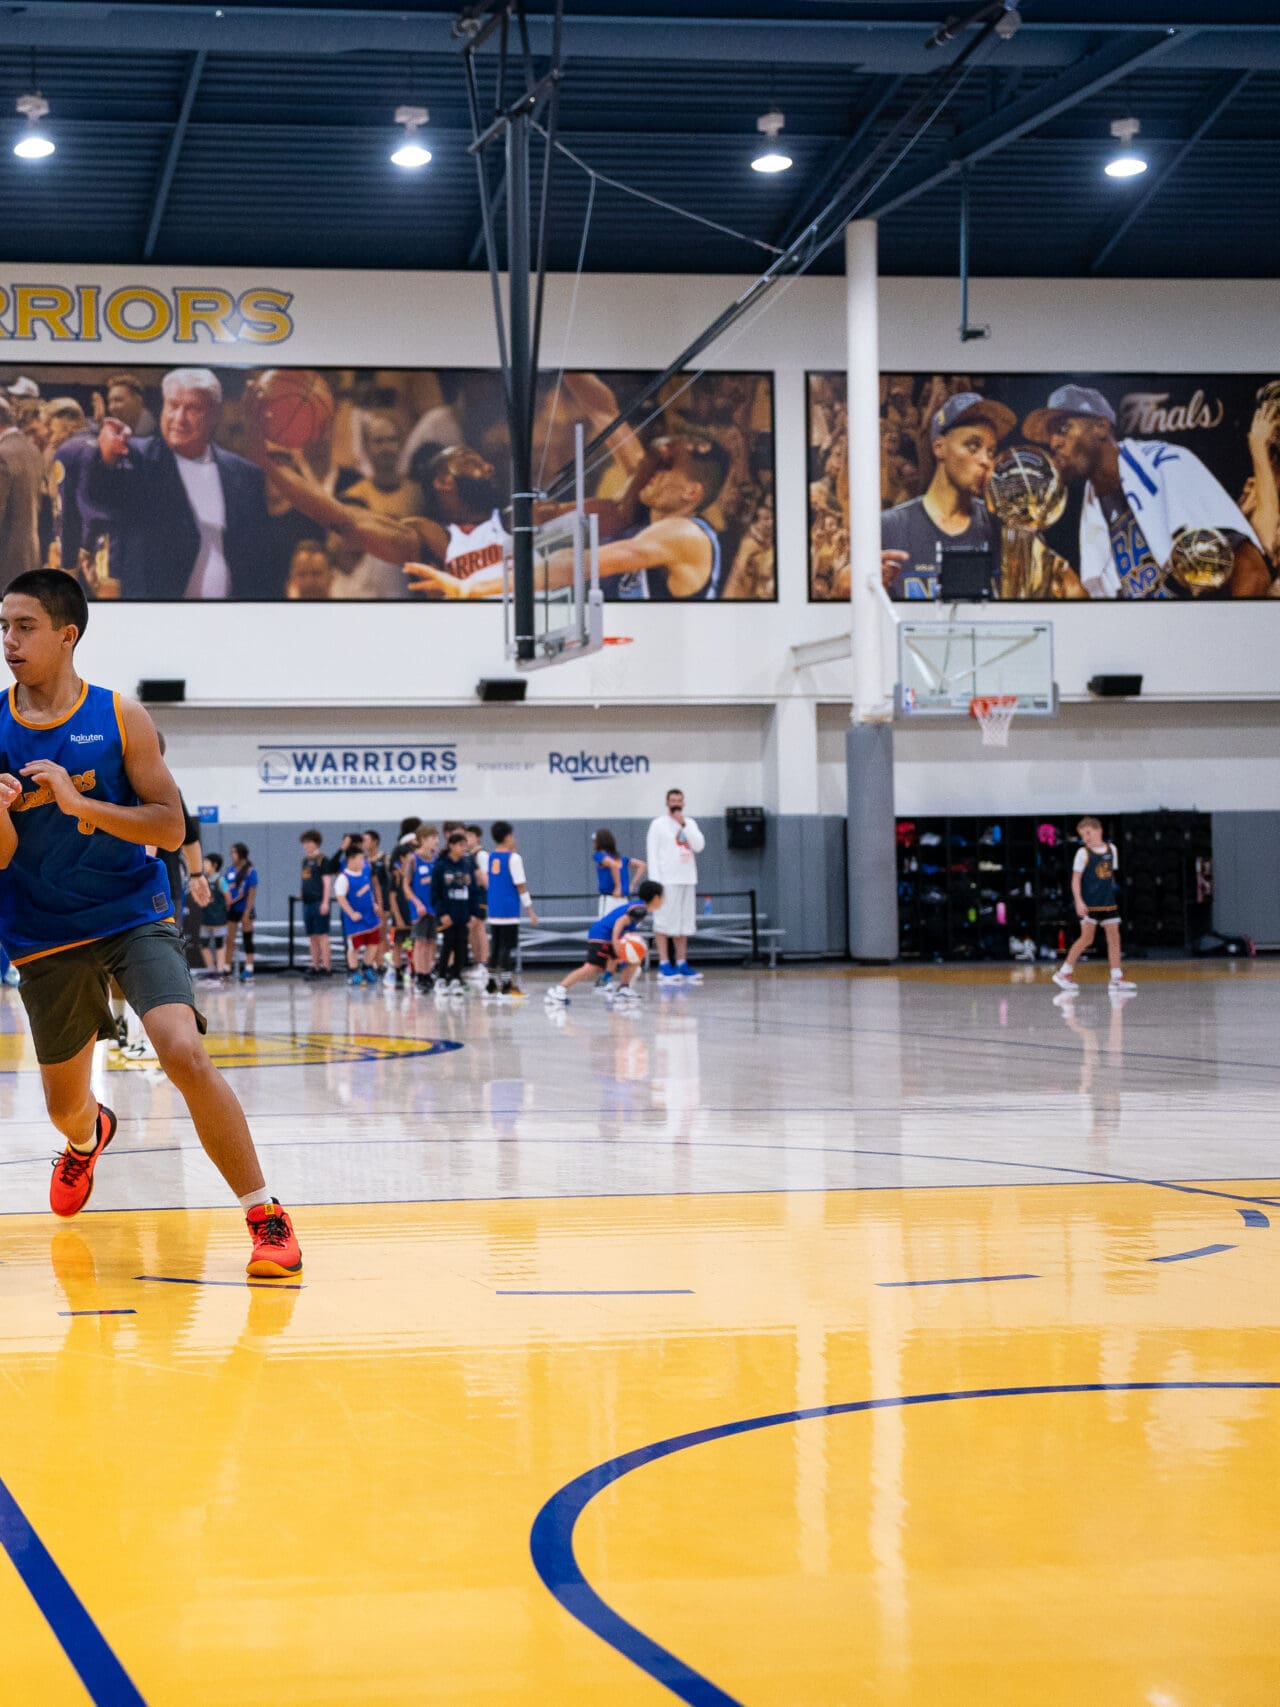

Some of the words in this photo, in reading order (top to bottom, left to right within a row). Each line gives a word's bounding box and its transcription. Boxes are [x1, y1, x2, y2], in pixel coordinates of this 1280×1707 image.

[1120, 389, 1224, 435] Finals
[70, 733, 104, 743] Rakuten
[292, 751, 458, 772] WARRIORS
[549, 751, 650, 774] Rakuten
[294, 774, 384, 786] BASKETBALL
[389, 773, 457, 785] ACADEMY
